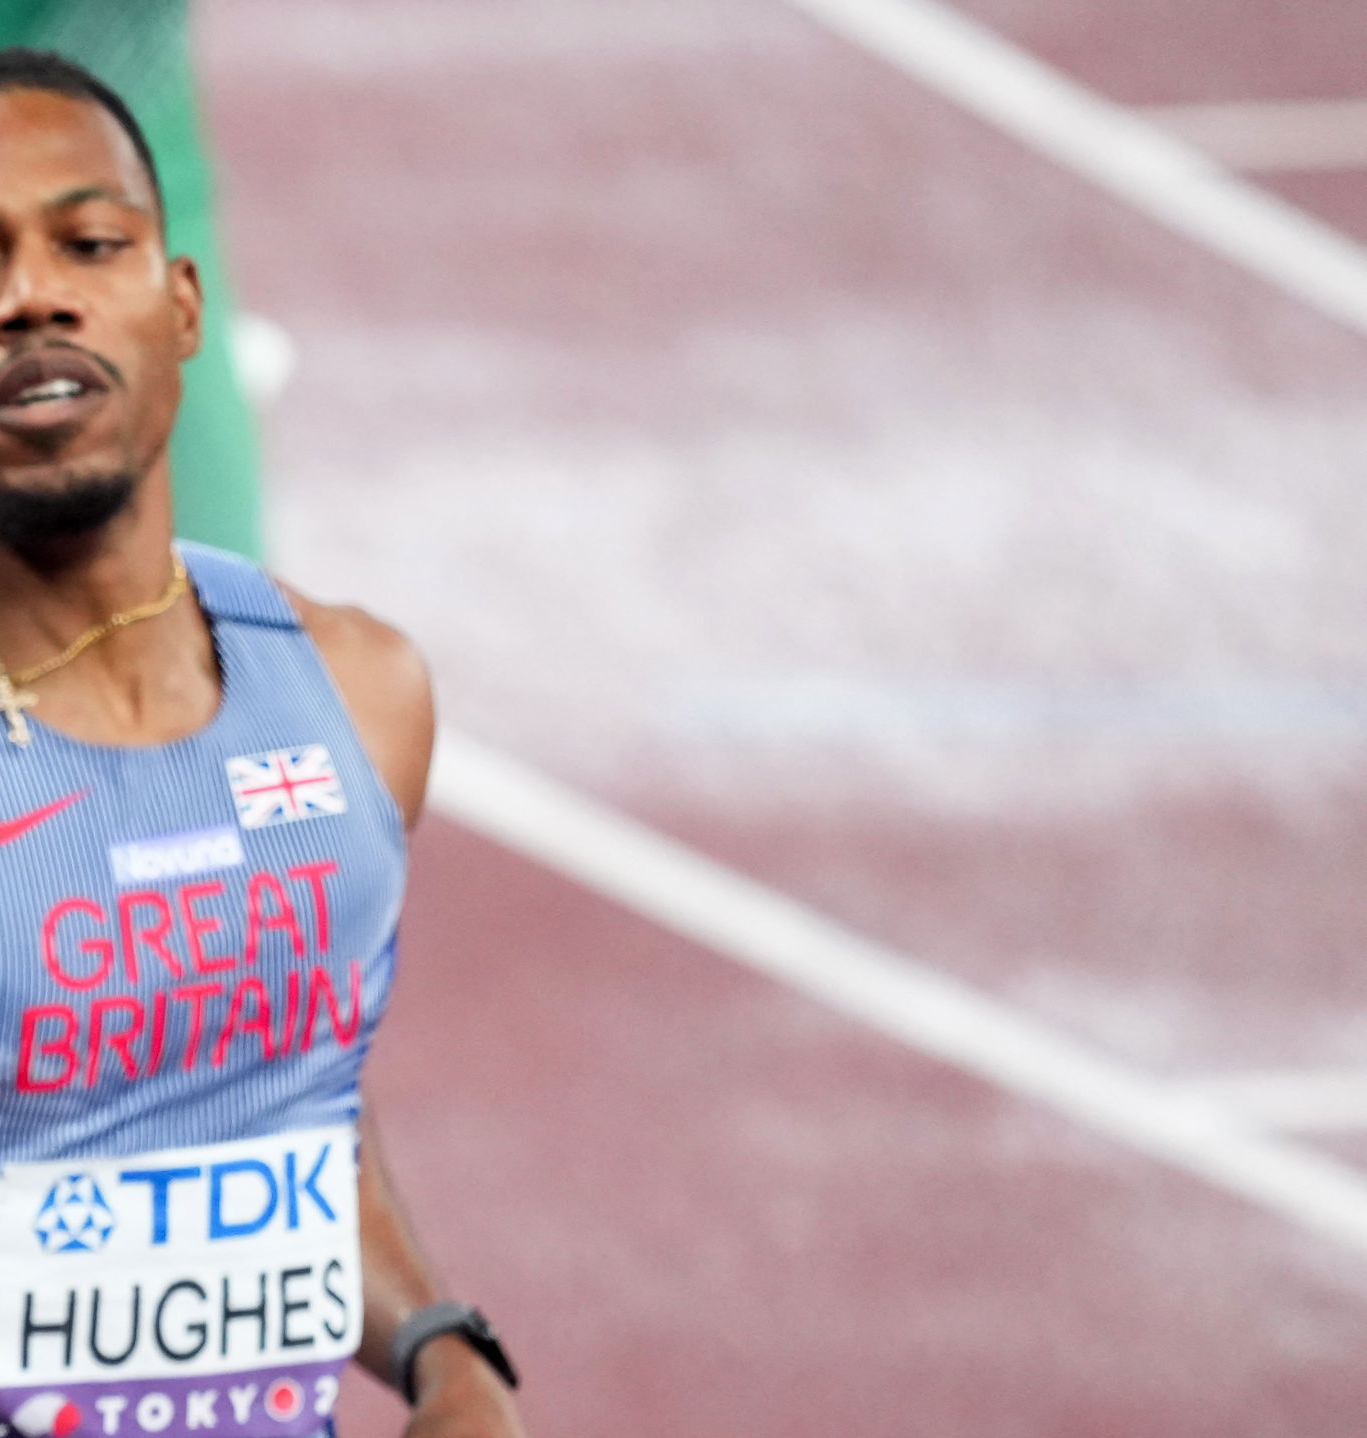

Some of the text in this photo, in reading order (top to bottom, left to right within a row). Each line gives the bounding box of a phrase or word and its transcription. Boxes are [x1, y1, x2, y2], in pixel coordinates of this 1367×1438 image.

[41, 860, 338, 993] GREAT
[17, 960, 360, 1094] BRITAIN
[120, 1144, 336, 1244] TDK
[22, 1258, 347, 1370] HUGHES
